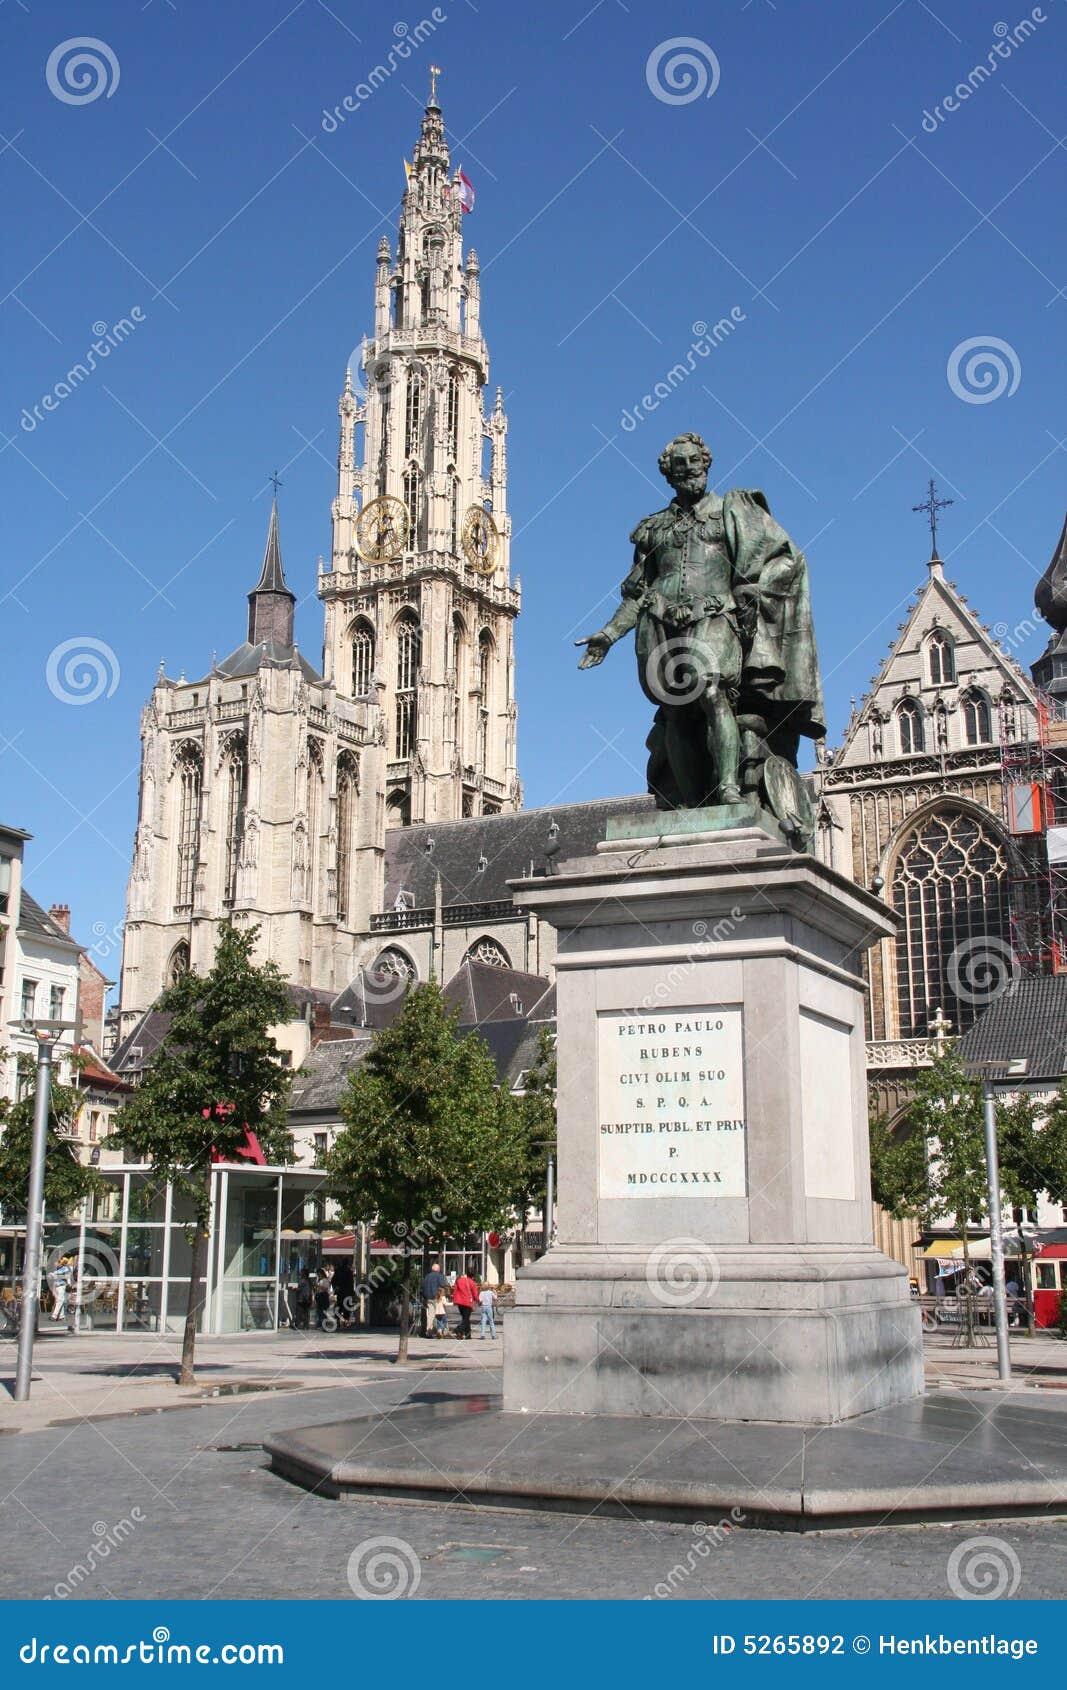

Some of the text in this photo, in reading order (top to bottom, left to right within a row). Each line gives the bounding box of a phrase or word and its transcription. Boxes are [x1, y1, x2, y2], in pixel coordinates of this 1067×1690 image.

[618, 1020, 724, 1036] PETRO PAULO
[639, 1046, 703, 1060] RUBENS
[619, 1069, 726, 1085] CIVI OLIM SUO
[696, 1120, 712, 1132] ET
[627, 1171, 722, 1185] MDCCCXXXX
